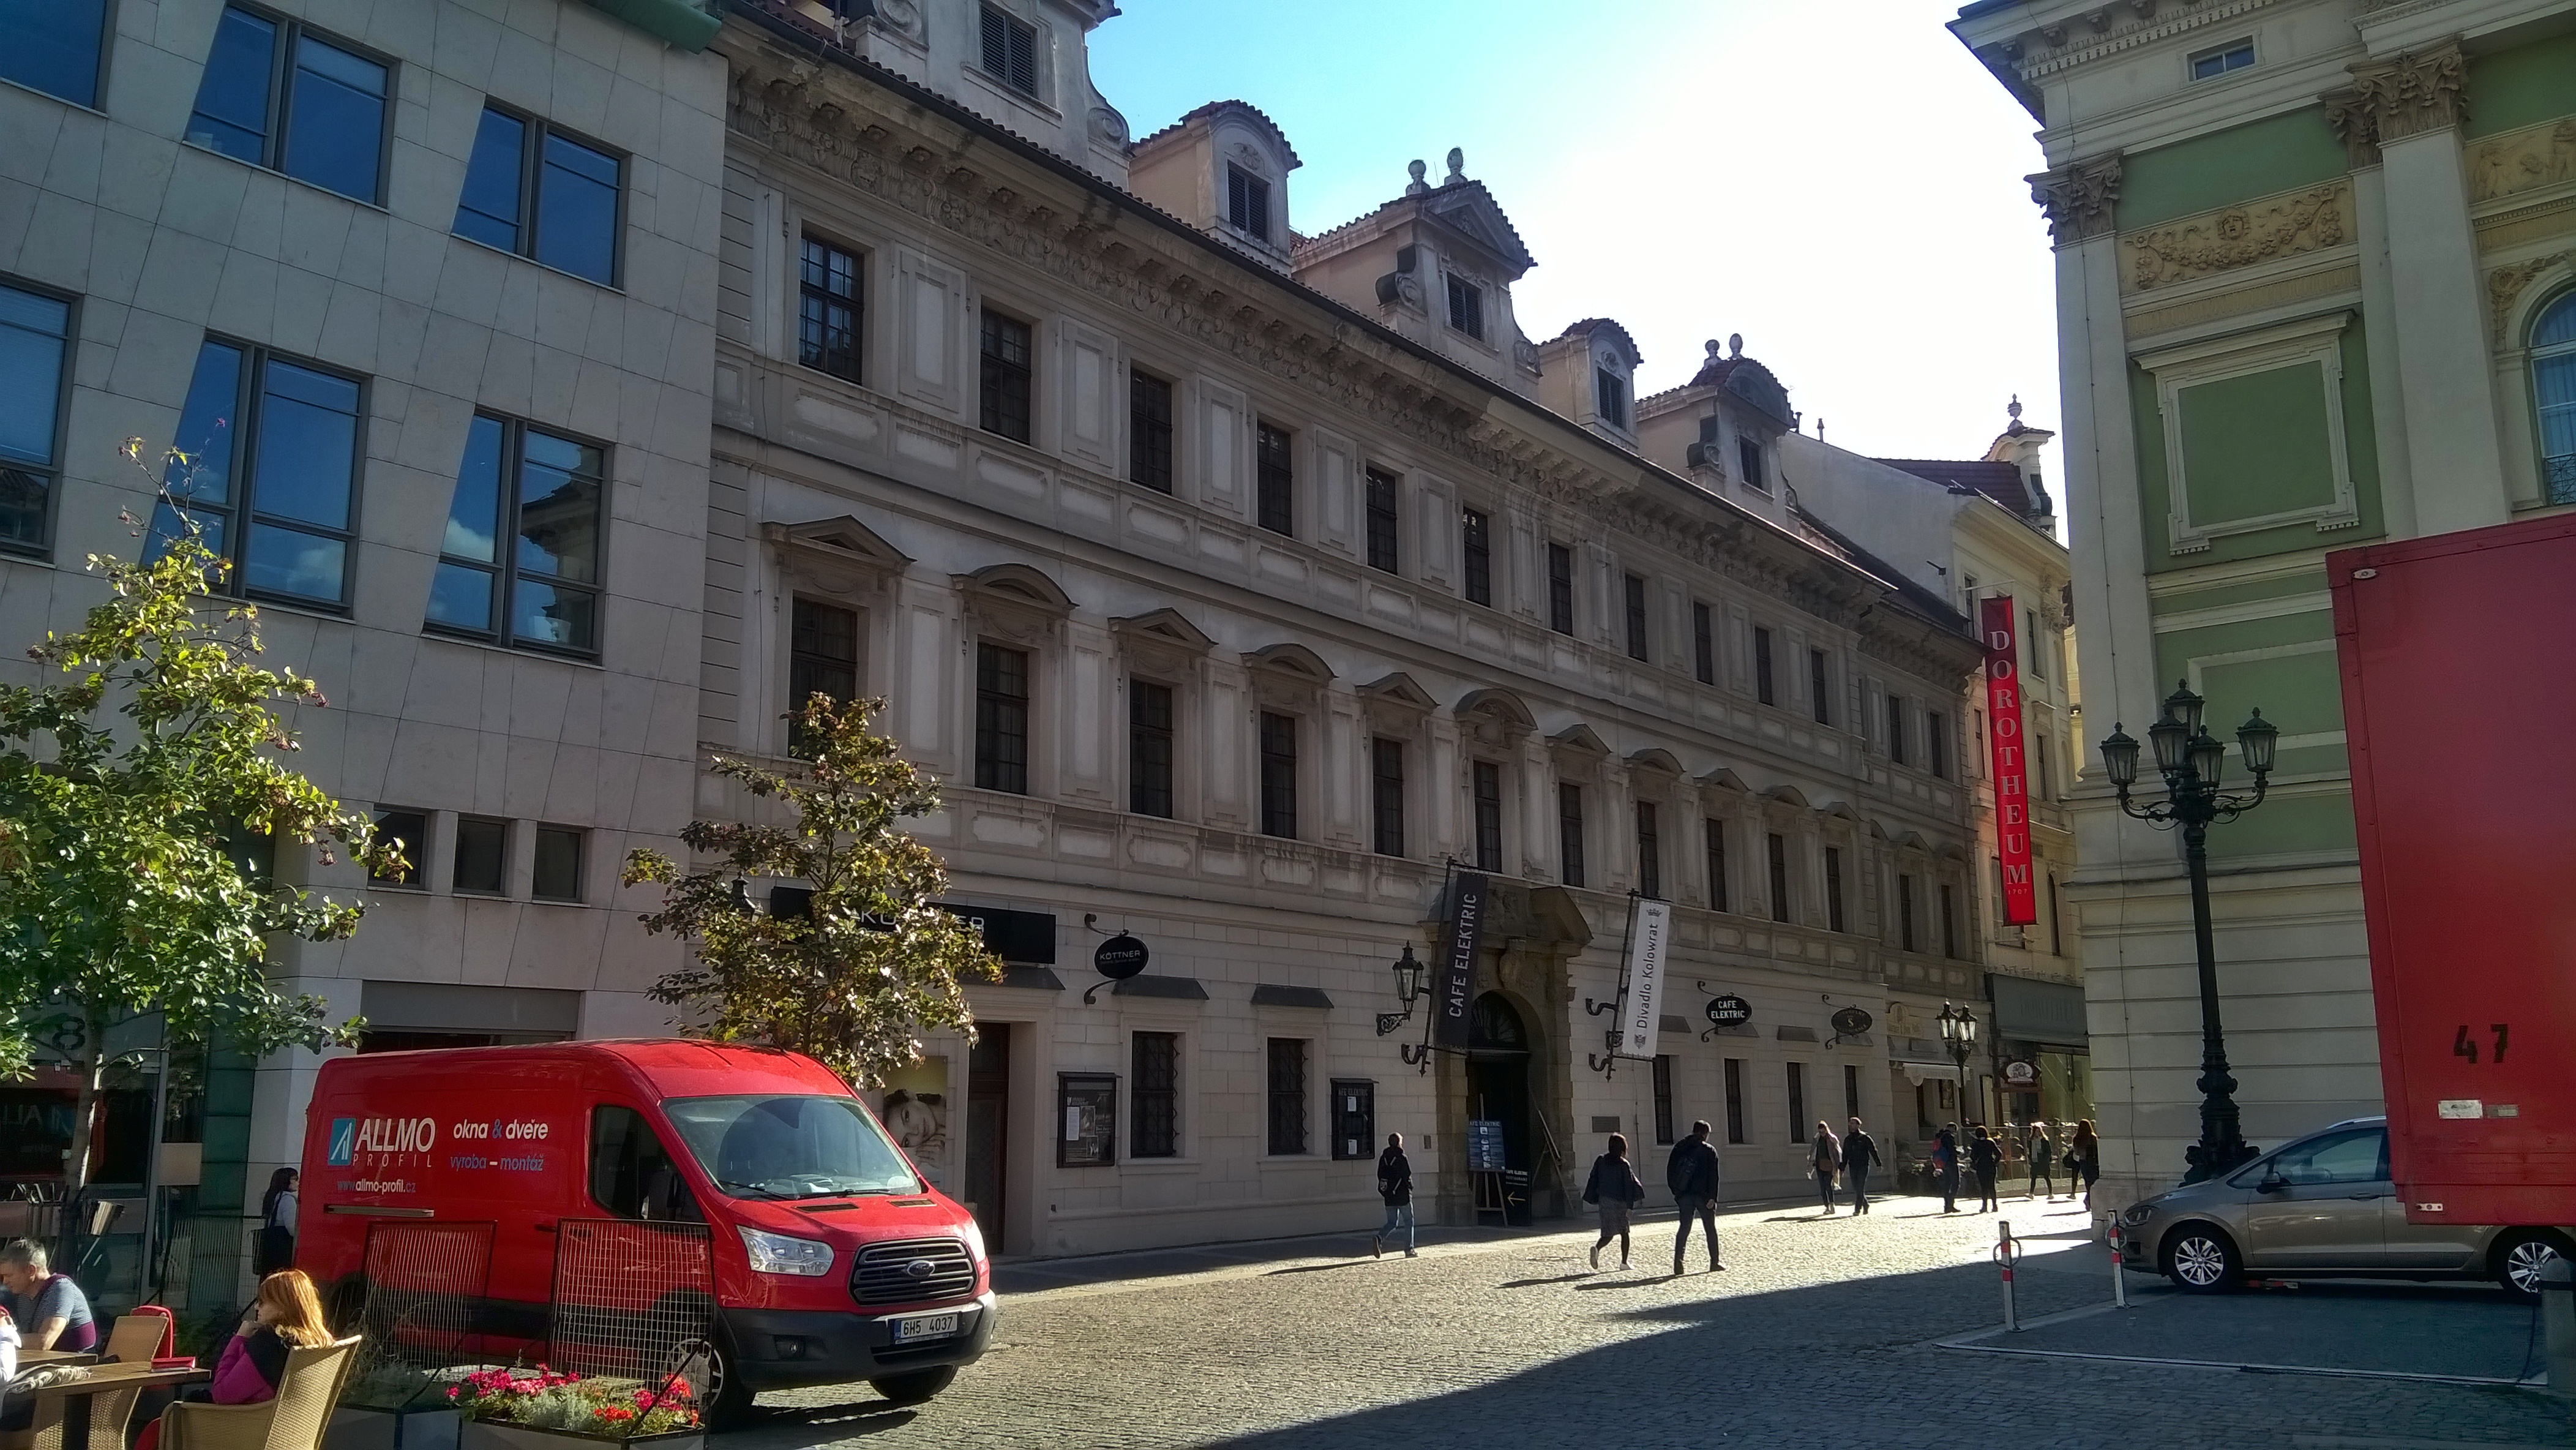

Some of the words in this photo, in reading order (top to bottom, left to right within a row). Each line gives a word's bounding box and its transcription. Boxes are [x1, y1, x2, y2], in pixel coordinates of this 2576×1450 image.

[1990, 630, 2028, 885] DOROTHEUM
[1455, 893, 1477, 970] ELEKTRIC
[1642, 923, 1658, 979] Kolowrat
[1448, 975, 1466, 1018] CAFE
[1636, 983, 1652, 1029] Divadlo
[1718, 1000, 1737, 1009] CAFE
[1710, 1010, 1745, 1019] ELEKTRIC
[2454, 1024, 2508, 1064] 47
[354, 1118, 435, 1152] ALLMO
[454, 1119, 489, 1139] okna
[492, 1118, 503, 1139] &
[506, 1119, 549, 1139] dveře
[352, 1154, 432, 1168] PROFIL
[451, 1152, 487, 1171] výroba
[500, 1154, 544, 1171] montáž
[337, 1179, 416, 1195] www.allmo-profil.cz
[903, 1320, 921, 1335] 6H5
[929, 1316, 953, 1332] 4037
